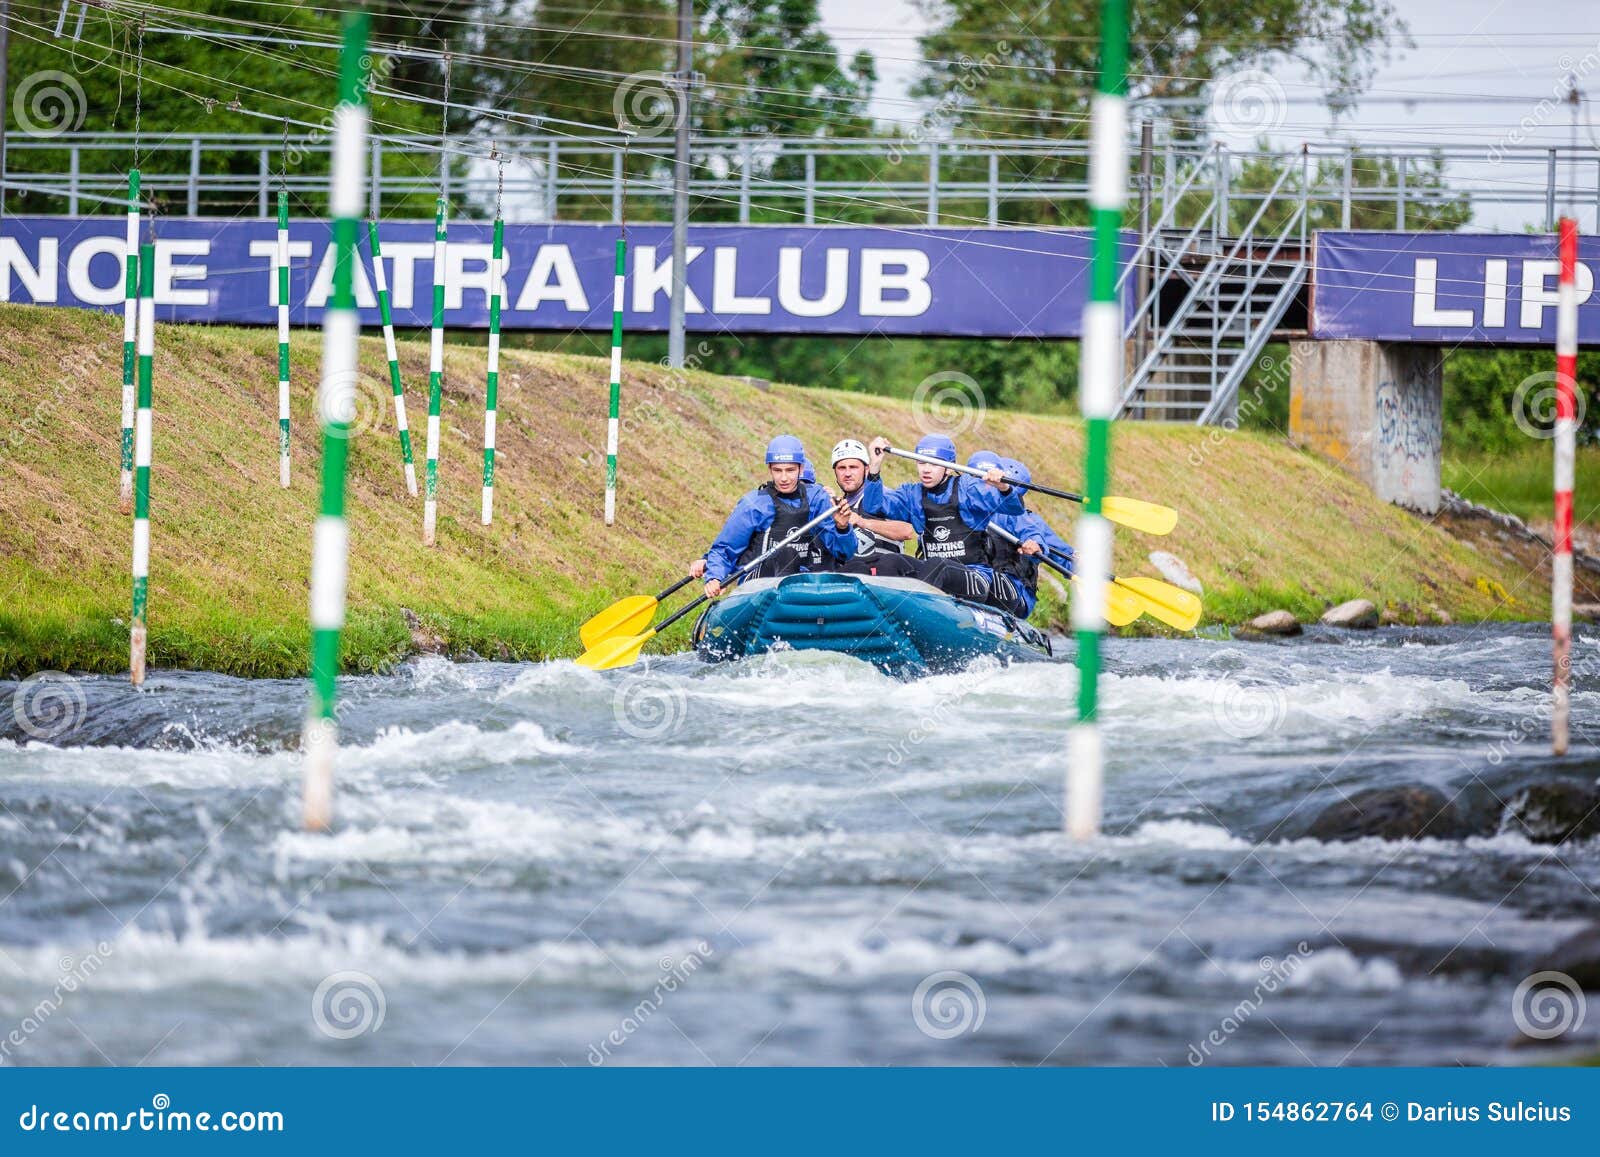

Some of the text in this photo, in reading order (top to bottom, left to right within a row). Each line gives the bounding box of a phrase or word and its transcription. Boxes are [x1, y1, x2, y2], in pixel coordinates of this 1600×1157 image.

[0, 236, 932, 317] NOE TATRA KLUB
[1412, 257, 1595, 329] LIP
